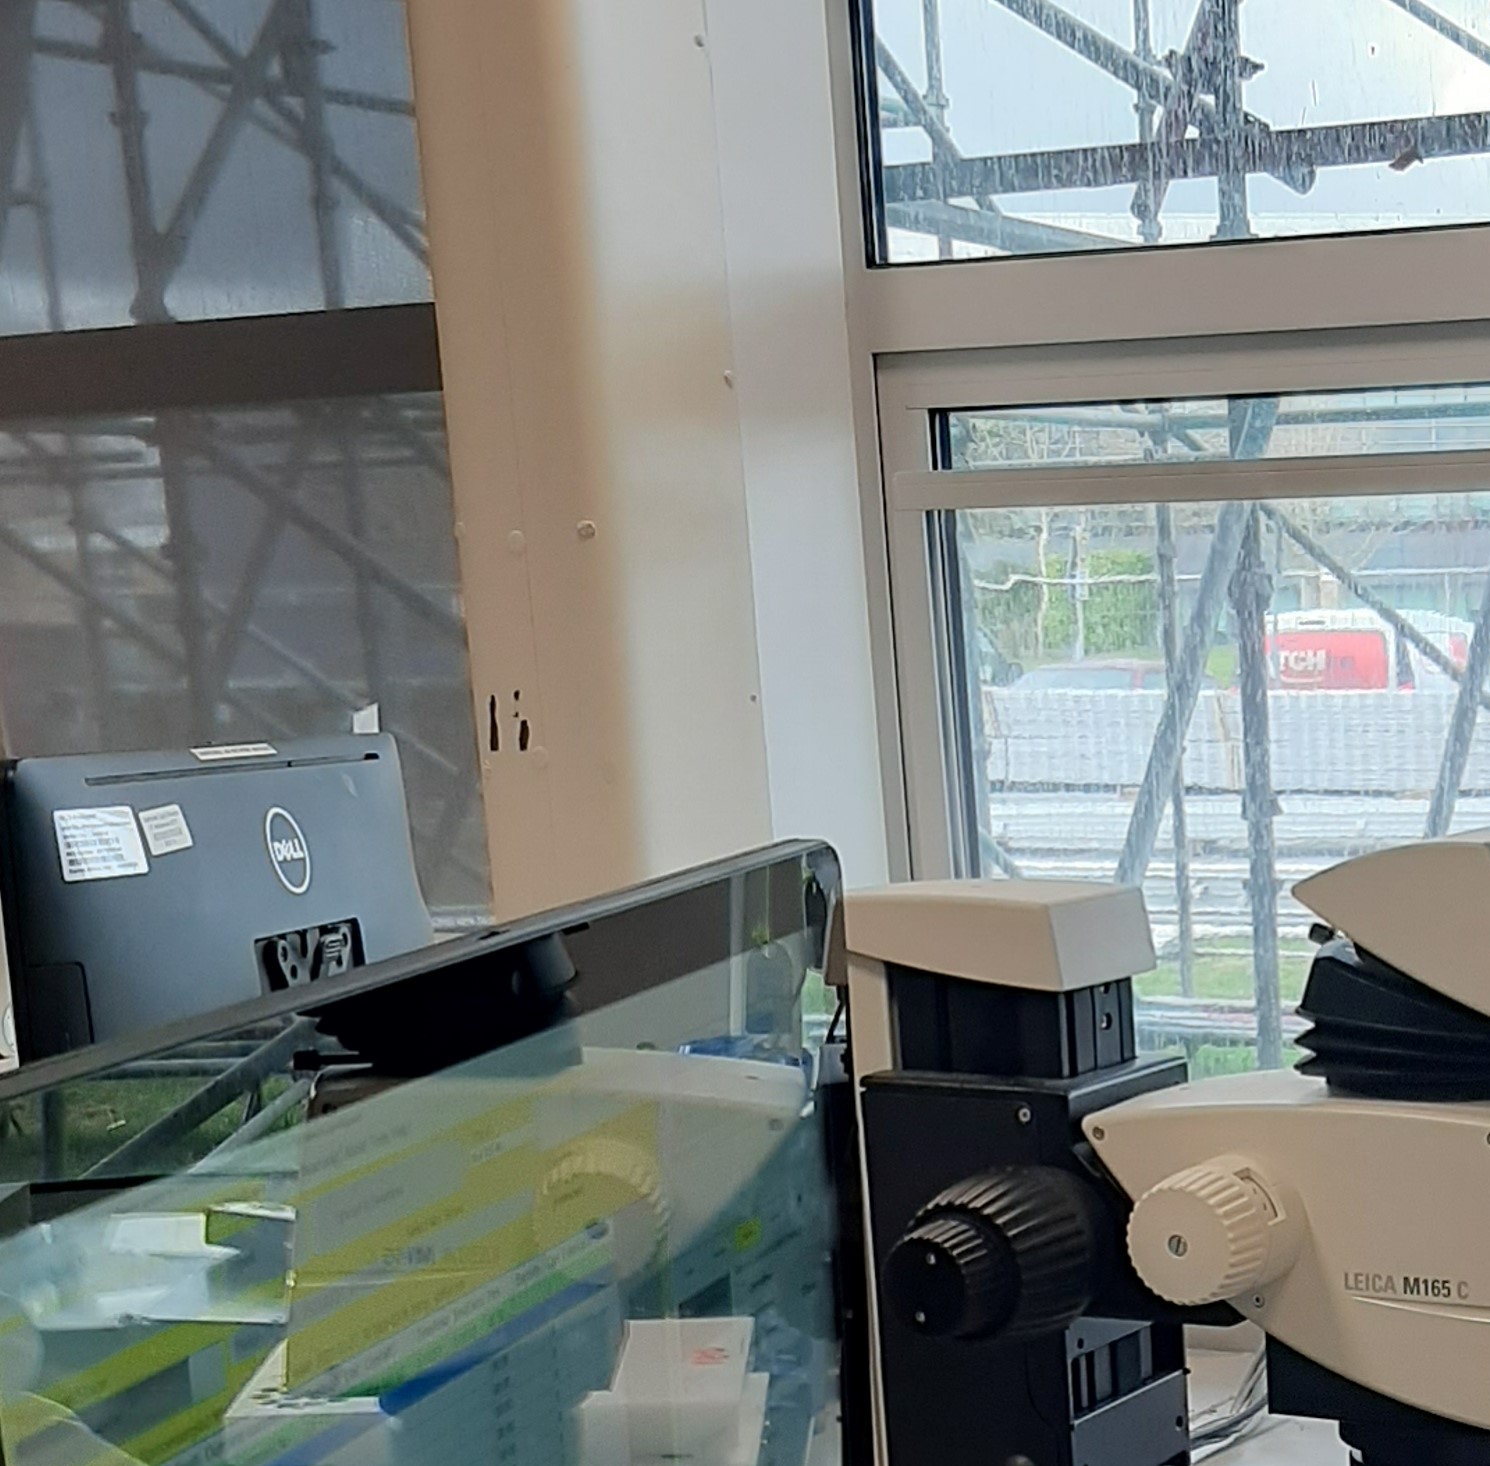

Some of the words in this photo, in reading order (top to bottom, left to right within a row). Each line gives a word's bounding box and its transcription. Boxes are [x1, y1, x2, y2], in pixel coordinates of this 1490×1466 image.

[1344, 1272, 1397, 1294] LEICA
[1403, 1276, 1451, 1298] M165
[1457, 1281, 1469, 1300] C
